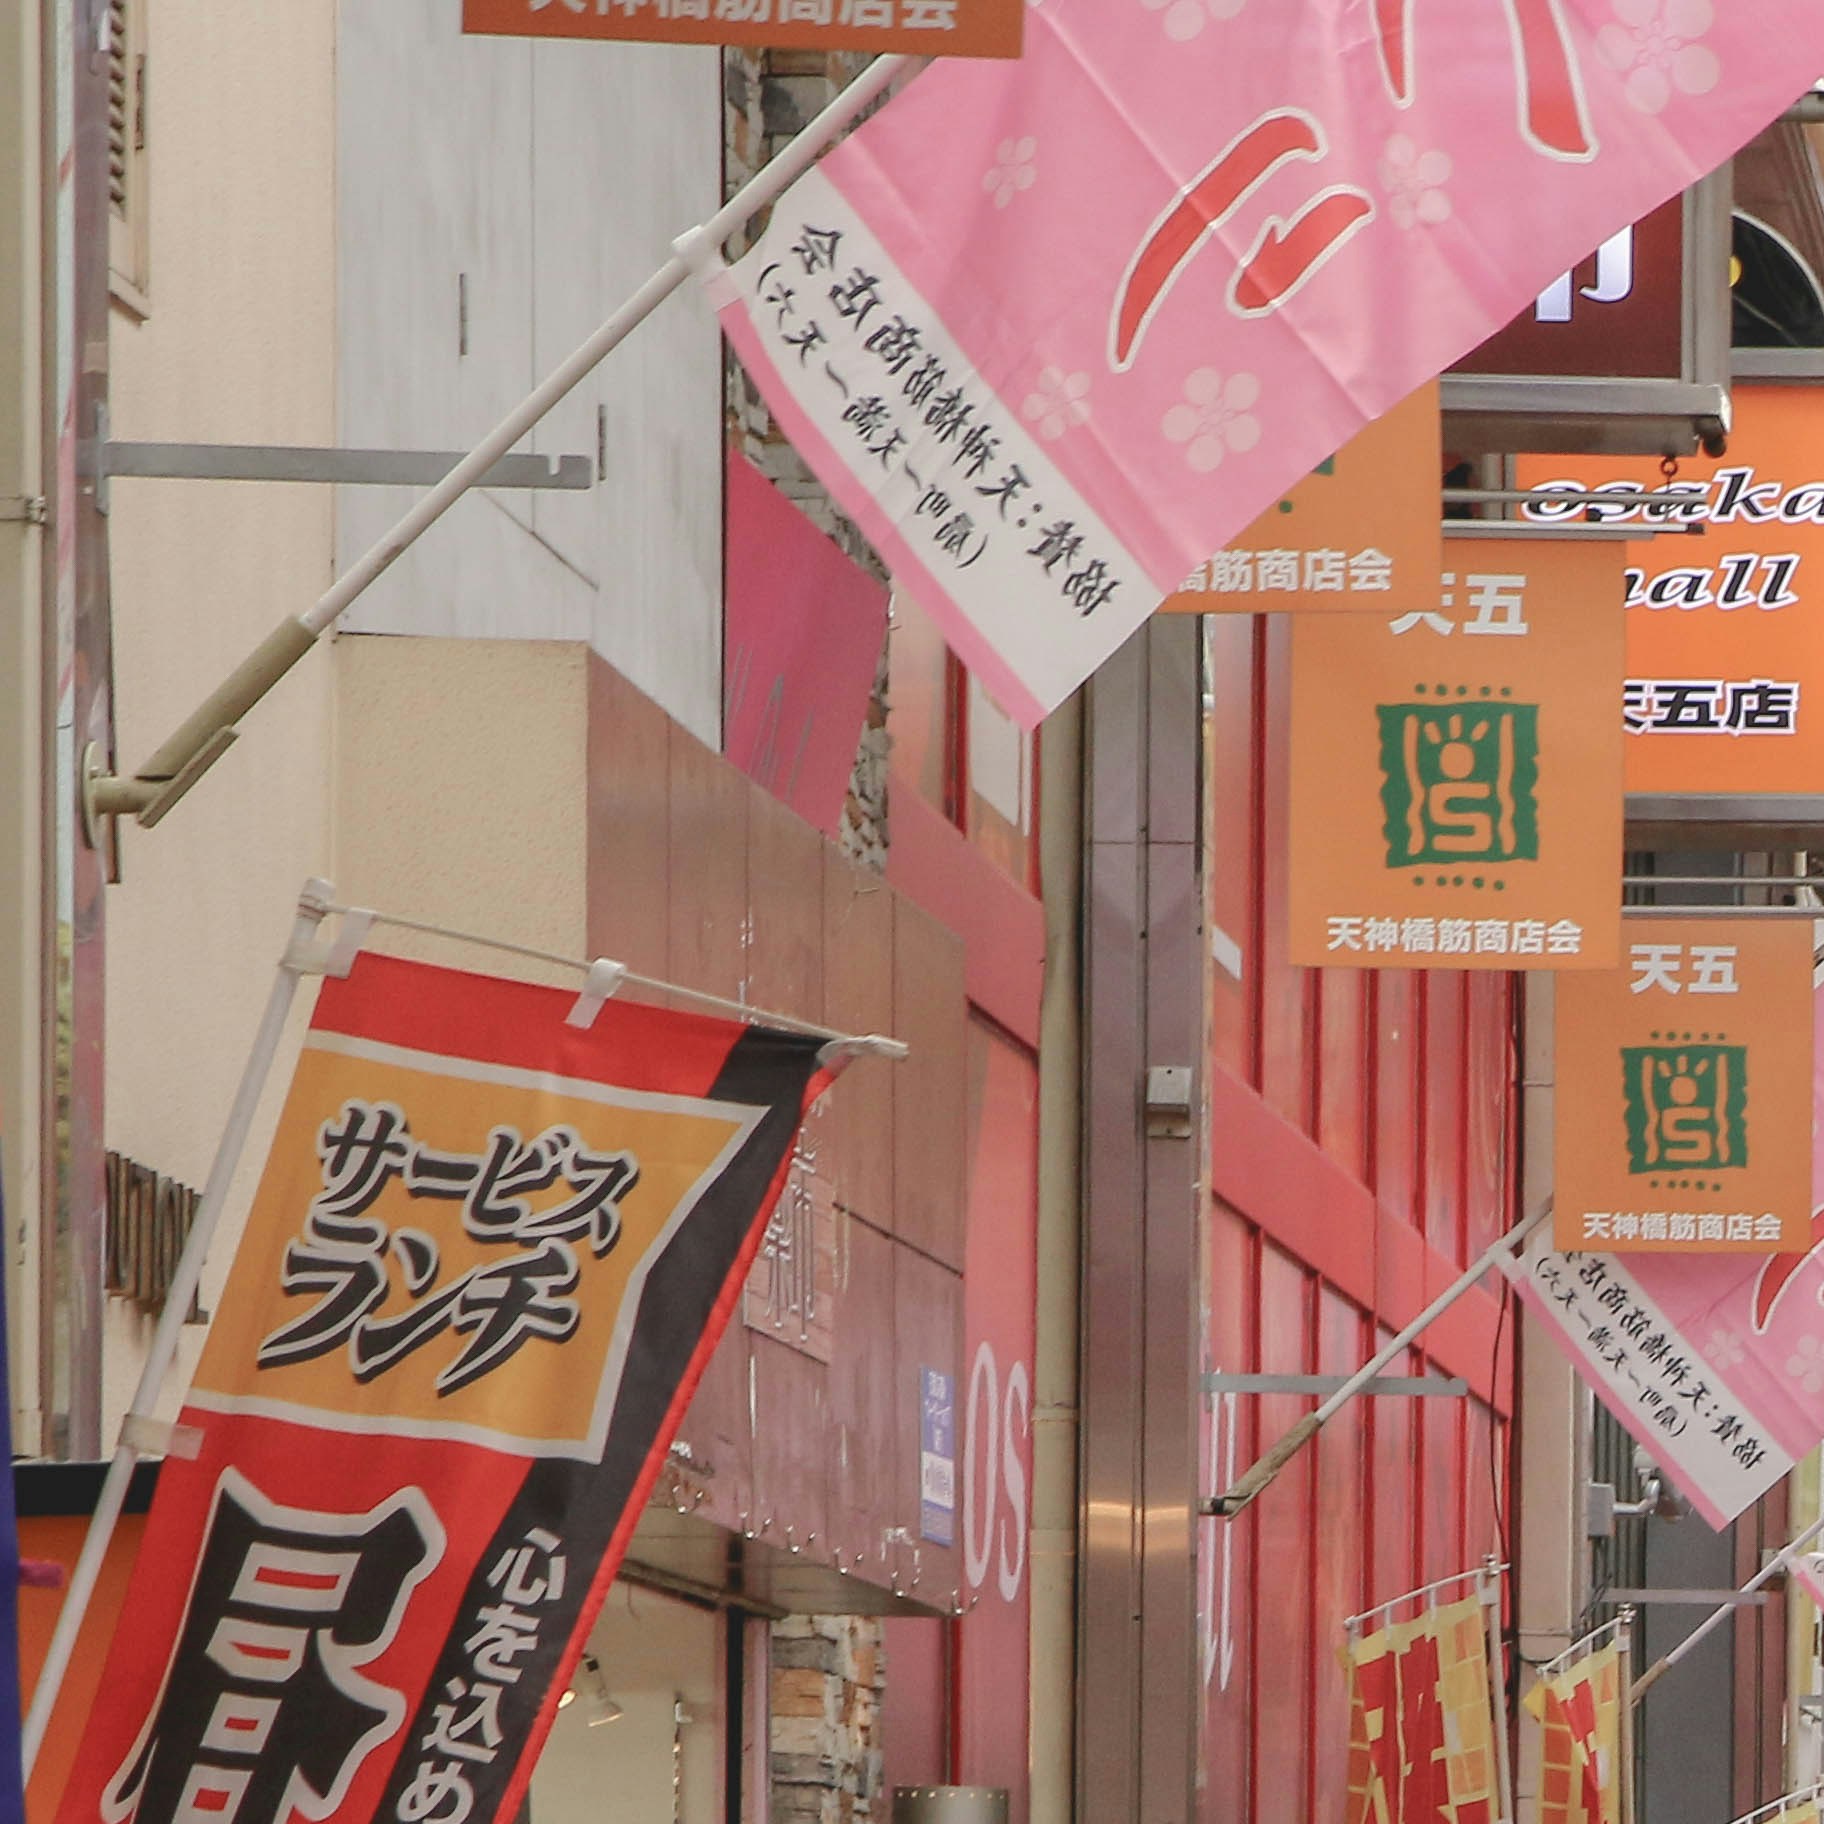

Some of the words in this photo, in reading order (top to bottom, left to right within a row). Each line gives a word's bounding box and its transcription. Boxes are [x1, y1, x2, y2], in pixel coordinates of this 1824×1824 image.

[1325, 915, 1585, 955] 天神橋筋商店会
[1630, 941, 1740, 995] 天五
[316, 1097, 642, 1261] サービス
[1581, 1209, 1784, 1243] 天神橋筋商店会
[255, 1216, 583, 1400] ランチ
